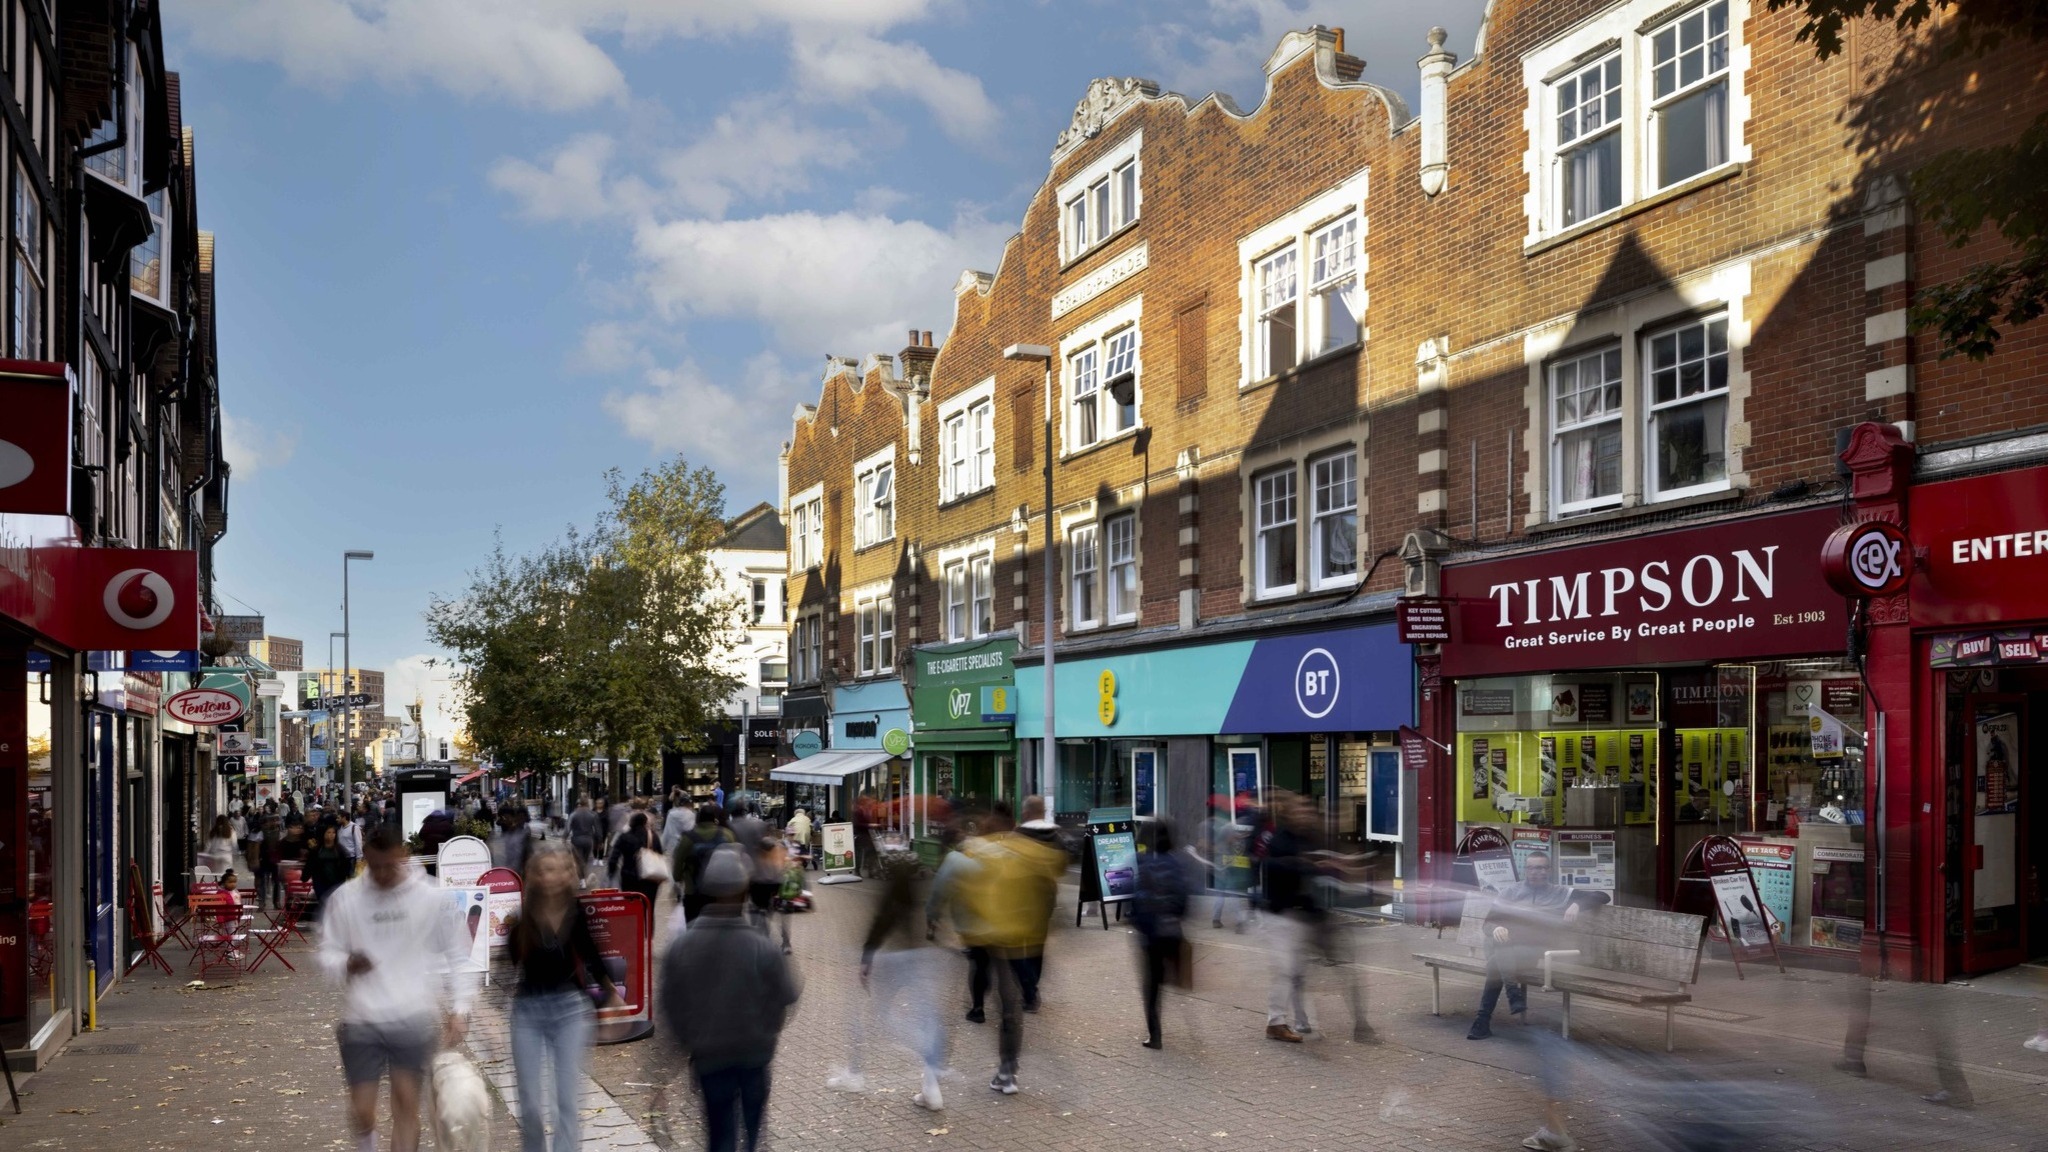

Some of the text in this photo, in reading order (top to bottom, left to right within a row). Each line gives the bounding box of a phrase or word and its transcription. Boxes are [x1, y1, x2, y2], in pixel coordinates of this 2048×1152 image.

[1489, 545, 1779, 628] TIMPSON
[1773, 610, 1826, 626] Est 1903
[1505, 614, 1755, 649] Great Service By Great People
[1962, 639, 1985, 655] BUY
[2005, 643, 2032, 657] SELL
[927, 661, 936, 675] THE
[968, 651, 1003, 670] SPECIALISTS
[1305, 670, 1329, 697] BT
[177, 695, 232, 716] Fentons
[951, 692, 971, 716] VPZ
[1097, 837, 1118, 845] DREAM
[1472, 834, 1504, 848] TIMPSON
[1707, 844, 1737, 861] TIMPSON
[1478, 861, 1510, 871] LIFETIME
